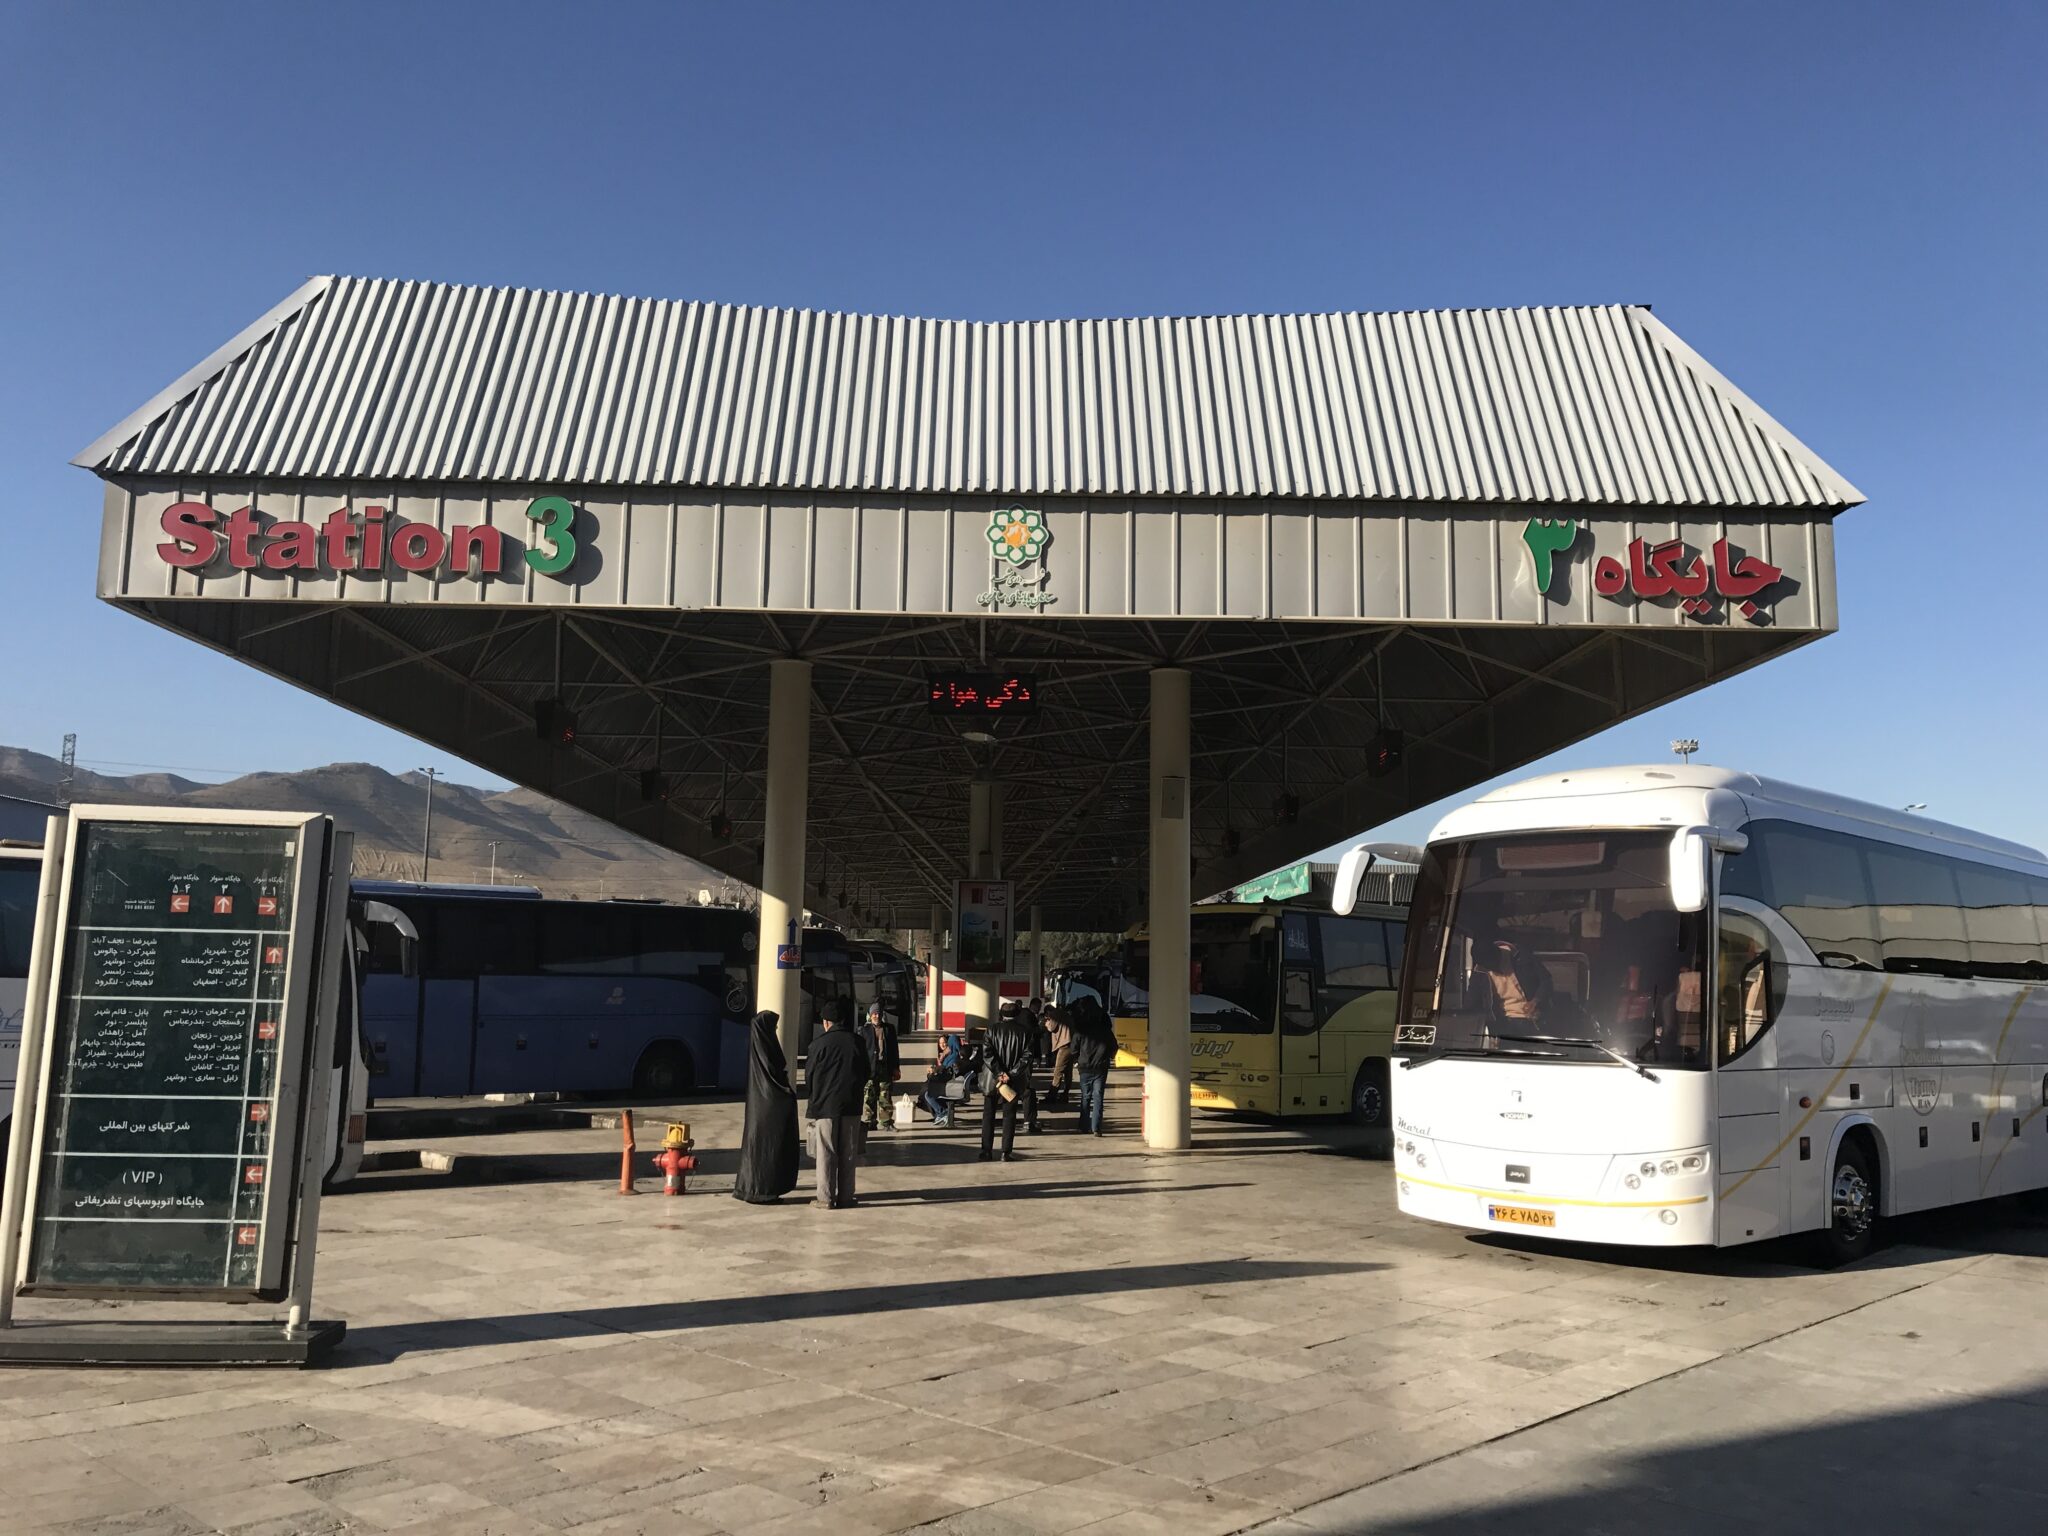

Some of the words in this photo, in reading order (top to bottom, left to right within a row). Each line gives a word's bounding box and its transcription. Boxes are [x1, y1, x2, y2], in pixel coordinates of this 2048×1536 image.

[155, 500, 503, 573] Station
[522, 495, 577, 575] 3
[1520, 516, 1577, 595] ۳
[1592, 535, 1784, 619] جایگاه
[91, 935, 107, 945] آباد
[107, 937, 125, 946] نجف
[132, 937, 157, 946] شهرضا
[231, 938, 251, 946] تهران
[93, 947, 118, 957] چالوس
[126, 948, 156, 956] شهرکرد
[202, 947, 227, 956] شهریار
[234, 948, 251, 958] کرج
[103, 958, 126, 967] نوشهر
[133, 959, 155, 968] تنکابن
[181, 957, 214, 966] کرمانشاه
[222, 958, 250, 966] شاهرود
[102, 968, 125, 977] رامسر
[95, 978, 118, 987] لنگرود
[126, 978, 154, 987] لاهیجان
[192, 978, 218, 987] اصفهان
[94, 1008, 111, 1017] شهر
[134, 1008, 149, 1017] بابل
[180, 1007, 198, 1016] زرند
[205, 1008, 228, 1017] کرمان
[235, 1008, 246, 1018] قم
[105, 1019, 117, 1027] نور
[124, 1019, 148, 1027] بابلسر
[212, 1019, 245, 1027] رفسنجان
[97, 1028, 124, 1037] زاهدان
[131, 1028, 147, 1038] آمل
[190, 1032, 212, 1040] زنجان
[219, 1032, 242, 1041] قزوین
[80, 1038, 101, 1048] چابهار
[193, 1043, 216, 1051] ارومیه
[222, 1043, 241, 1052] تبریز
[85, 1049, 107, 1058] شیراز
[114, 1050, 145, 1059] ایرانشهر
[184, 1052, 209, 1062] اردبیل
[215, 1053, 240, 1062] همدان
[191, 1063, 215, 1072] کاشان
[221, 1064, 240, 1072] اراک
[163, 1073, 187, 1083] بوشهر
[194, 1074, 216, 1082] ساری
[222, 1074, 239, 1083] زابل
[99, 1120, 128, 1132] المللی
[129, 1123, 146, 1133] بین
[1397, 1116, 1431, 1136] Maral
[74, 1195, 122, 1208] تشریفاتی
[175, 1196, 205, 1208] جایگاه
[1495, 1207, 1508, 1219] ۲۶
[1520, 1210, 1540, 1224] ۷۸۵
[1541, 1214, 1554, 1225] ۴۲
